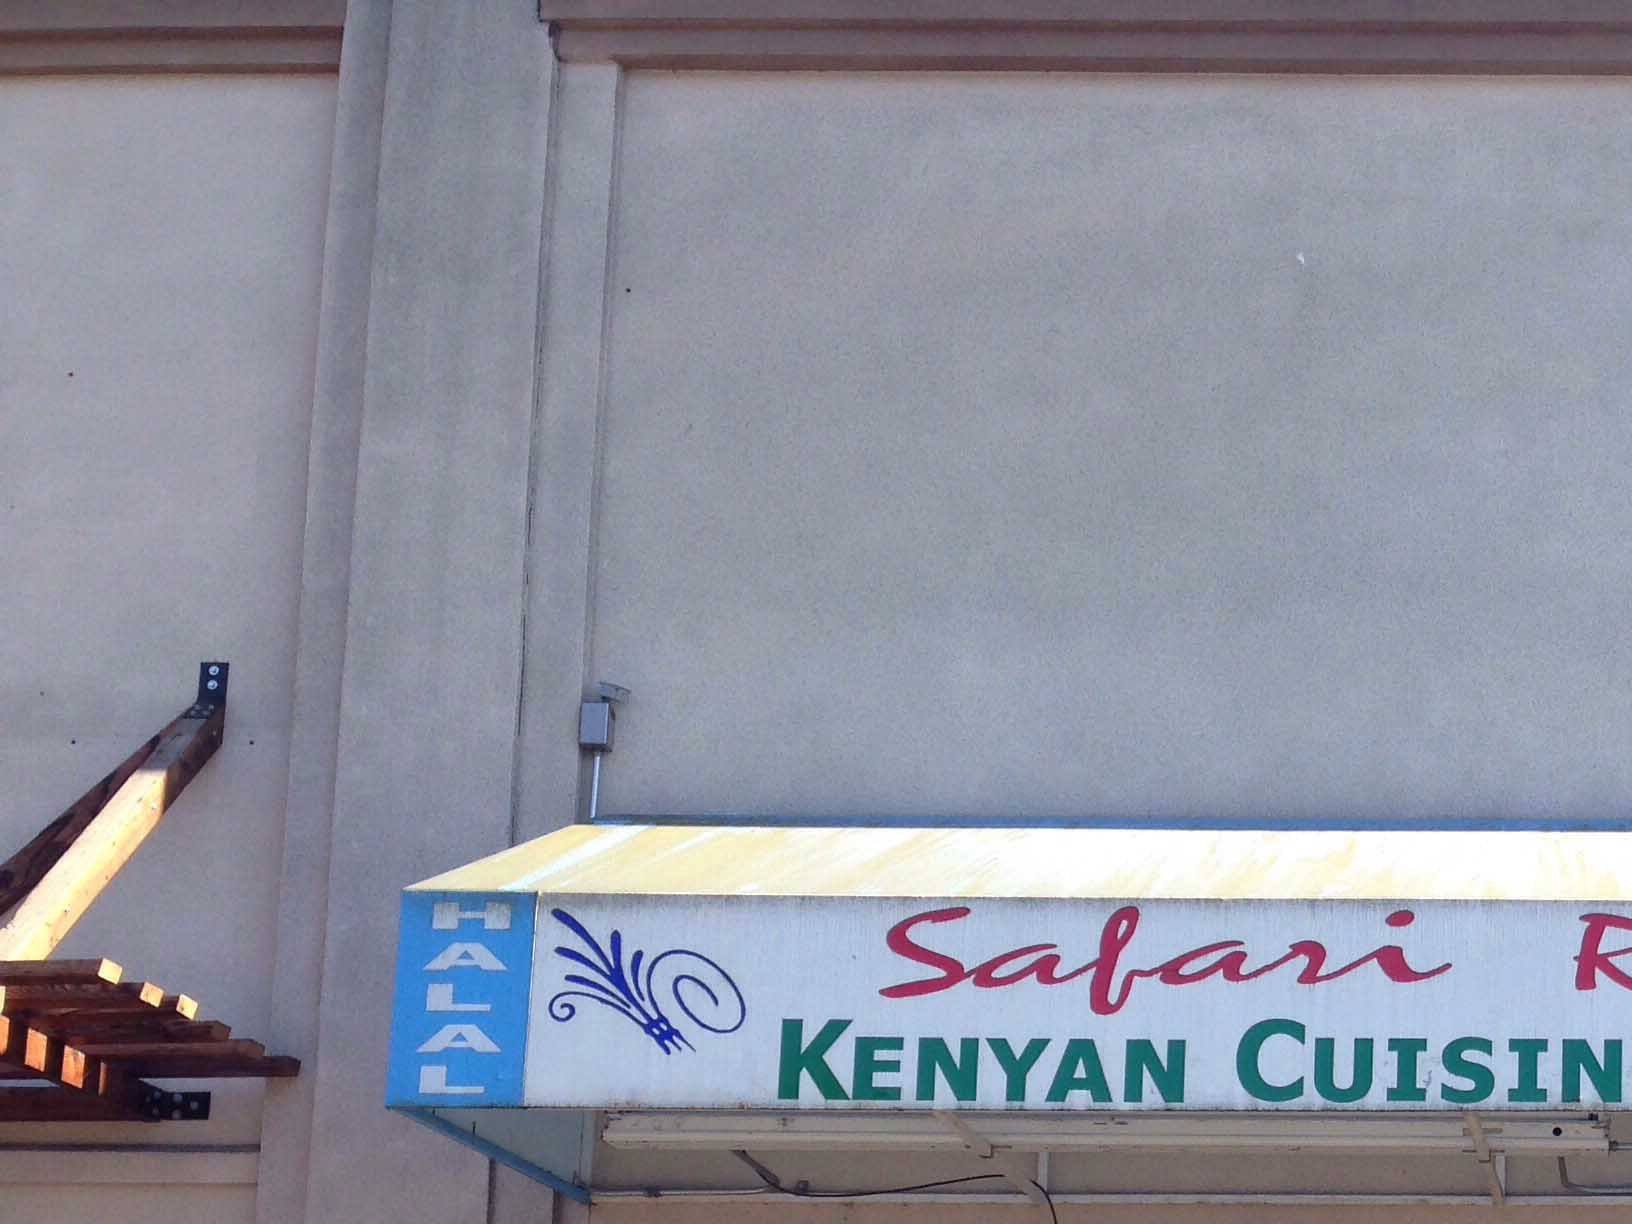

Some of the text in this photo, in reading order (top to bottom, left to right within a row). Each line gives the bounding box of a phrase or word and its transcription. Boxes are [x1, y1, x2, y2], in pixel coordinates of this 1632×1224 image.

[416, 901, 512, 1096] HALAL
[879, 906, 1453, 1015] Safari
[777, 1018, 1187, 1103] KENYAN
